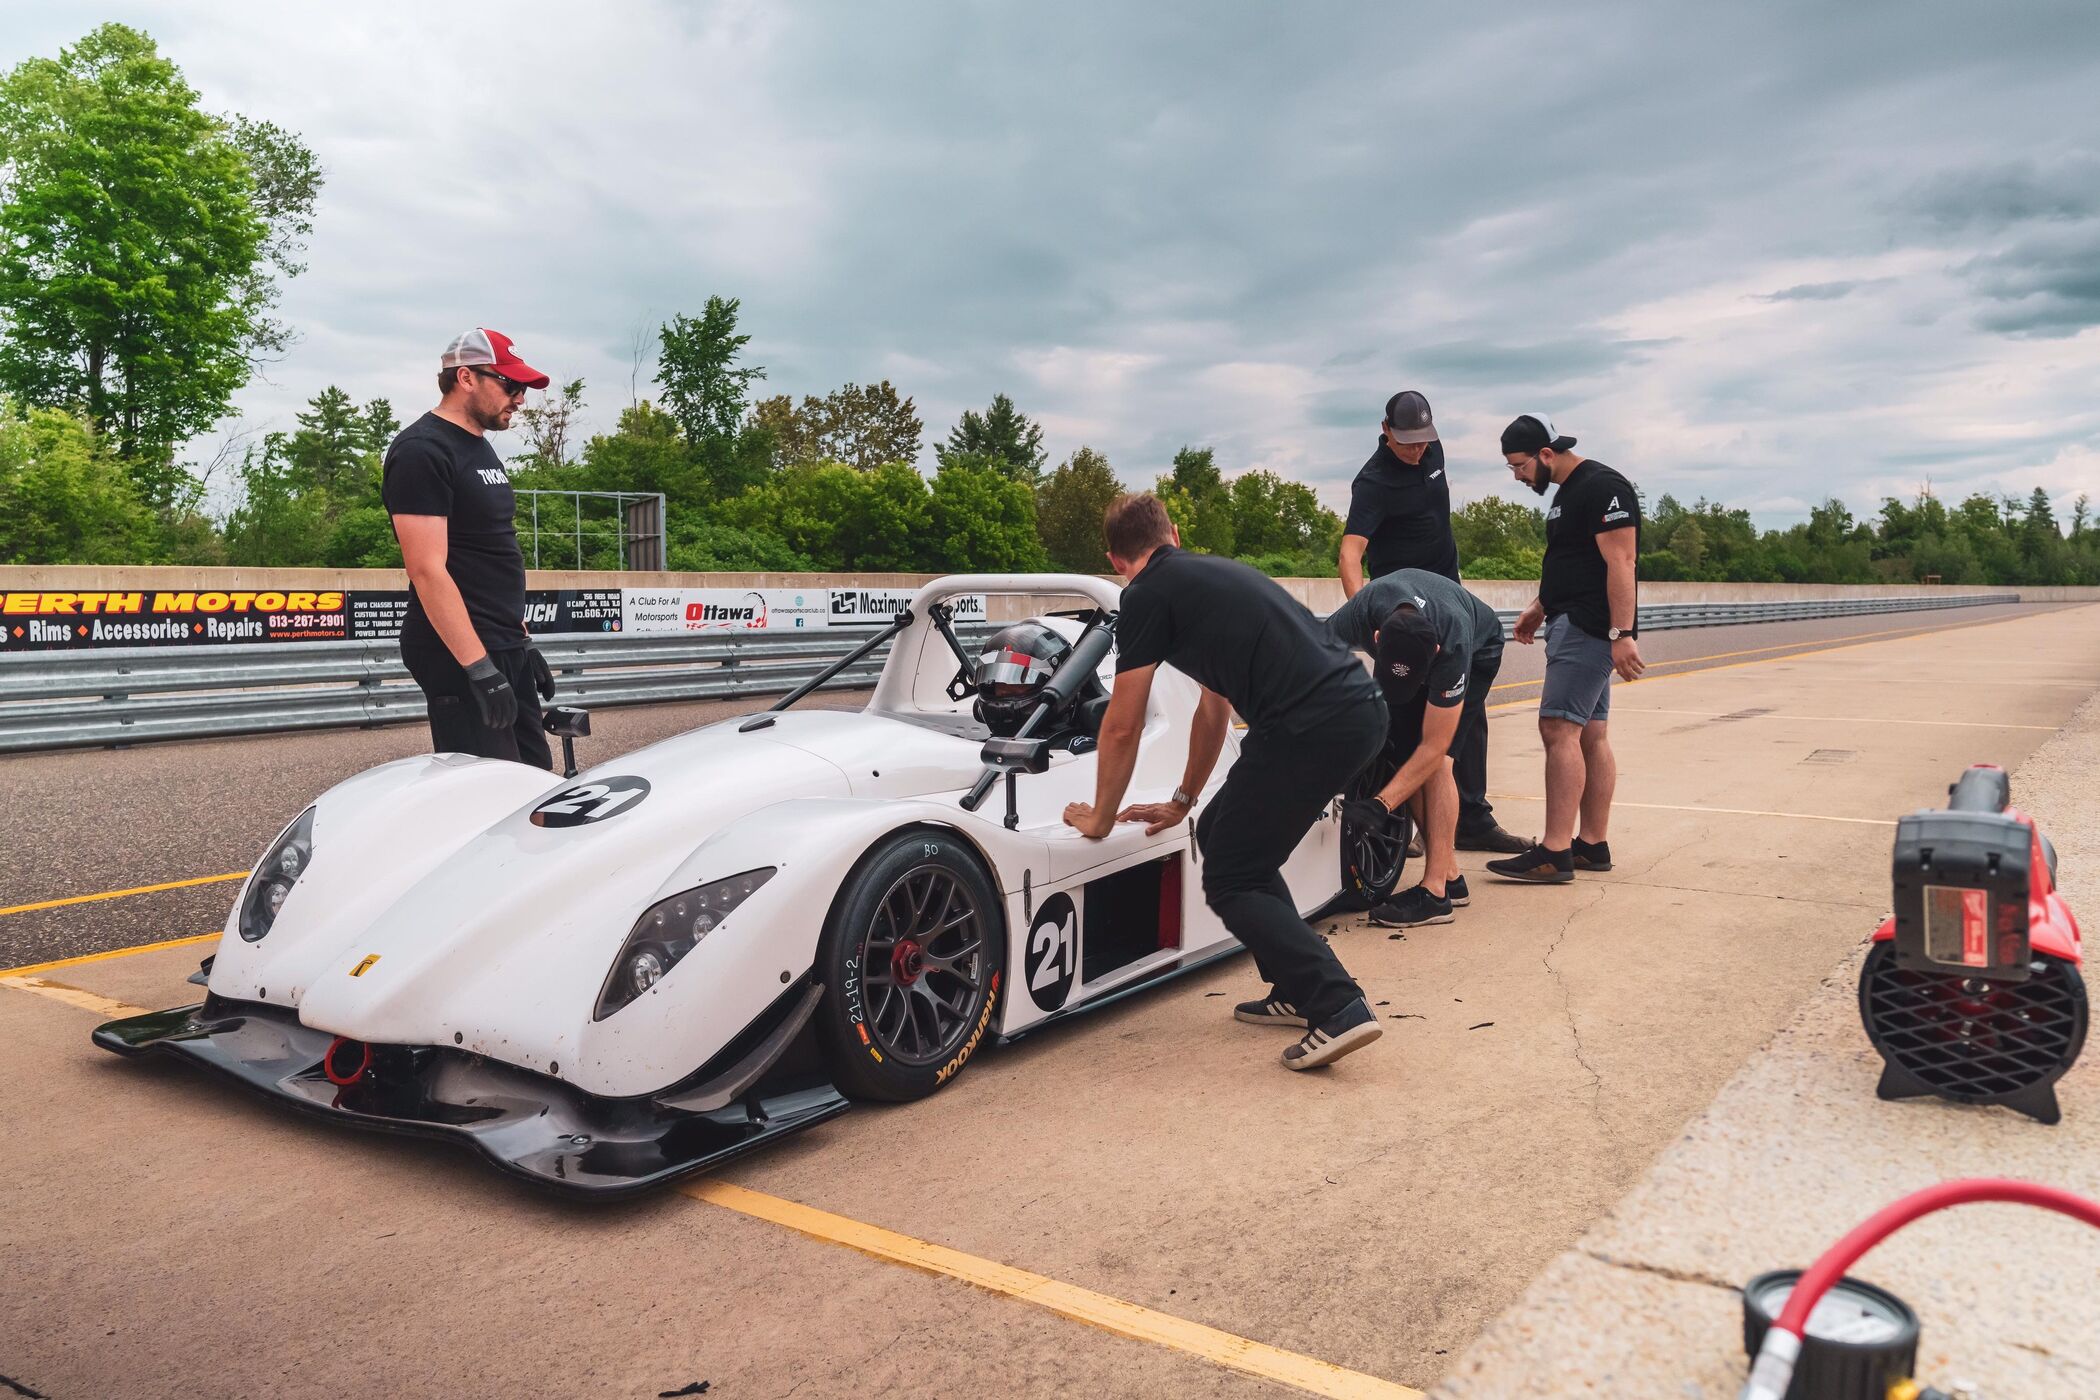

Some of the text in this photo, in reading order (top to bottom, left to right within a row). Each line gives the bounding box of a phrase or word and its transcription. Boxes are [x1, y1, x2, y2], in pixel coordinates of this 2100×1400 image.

[0, 592, 344, 614] ERTH MOTORS
[638, 597, 656, 606] Club
[671, 597, 680, 605] All
[635, 613, 678, 622] Motorsports
[686, 603, 754, 620] Ottawa
[29, 620, 72, 642] Rims
[92, 618, 189, 640] Accessories
[207, 617, 263, 641] Repairs
[269, 615, 344, 628] 613-267-2901
[269, 630, 345, 639] www.perthmotors.ca
[536, 784, 645, 819] 21
[1031, 910, 1074, 992] 21
[845, 955, 864, 1025] 21-19-2
